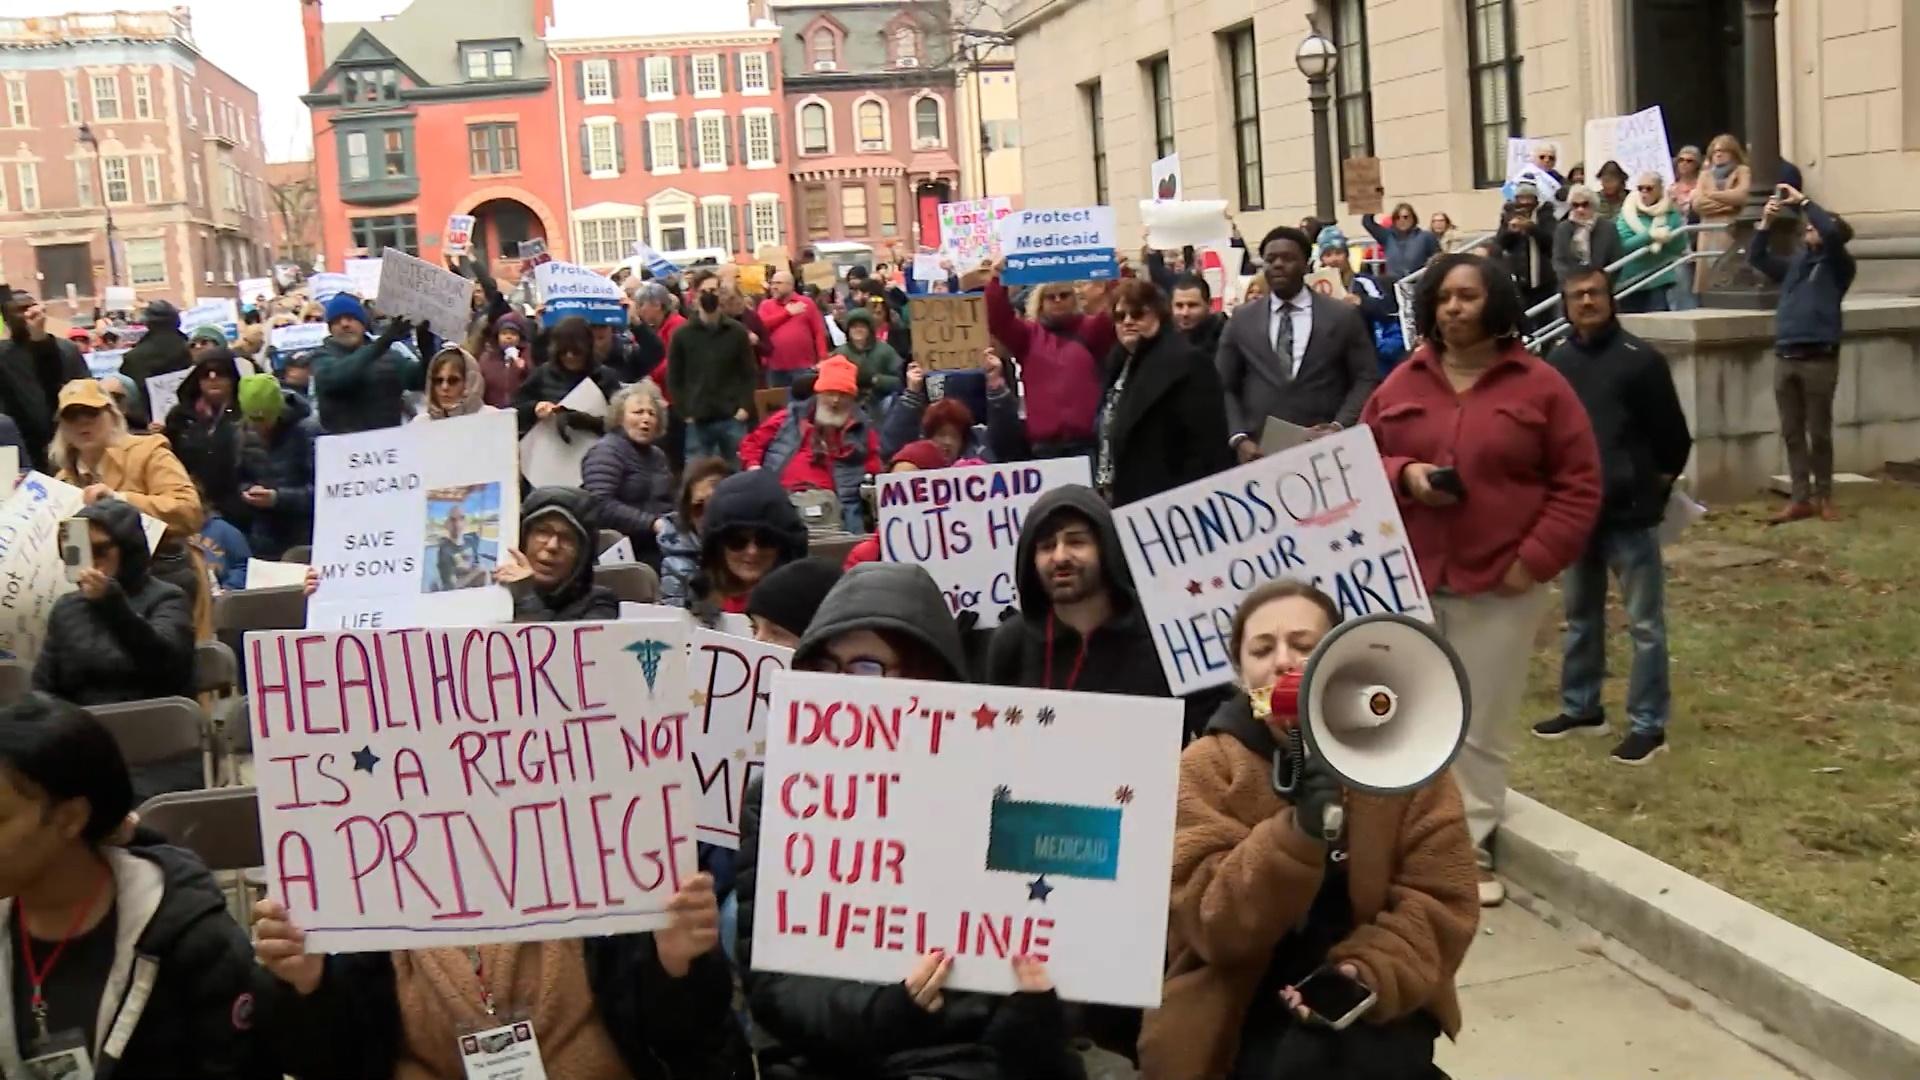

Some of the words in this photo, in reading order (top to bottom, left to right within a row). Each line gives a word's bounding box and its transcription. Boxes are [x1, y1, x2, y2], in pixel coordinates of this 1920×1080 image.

[1023, 210, 1090, 224] Protect
[1016, 231, 1100, 248] Medicaid
[922, 325, 973, 344] CUT
[349, 449, 399, 468] SAVE
[324, 474, 419, 499] MEDICAID
[881, 468, 1042, 508] MEDICAID
[1127, 479, 1277, 577] HANDS
[1276, 446, 1357, 522] OFF
[344, 531, 395, 549] SAVE
[886, 506, 972, 562] CUTS
[321, 562, 349, 580] MY
[355, 557, 415, 577] SON'S
[1228, 535, 1306, 591] OUR
[341, 612, 383, 629] LIFE
[252, 625, 606, 738] HEALTHCARE
[787, 695, 956, 755] DON'T
[269, 753, 351, 810] IS
[394, 748, 429, 801] A
[449, 714, 617, 797] RIGHT
[620, 712, 689, 772] NOT
[780, 772, 900, 820] CUT
[277, 830, 318, 912] A
[335, 783, 688, 920] PRIVILEGE
[784, 832, 907, 885] OUR
[1034, 836, 1110, 863] MEDICAID
[776, 889, 1056, 963] LIFELINE
